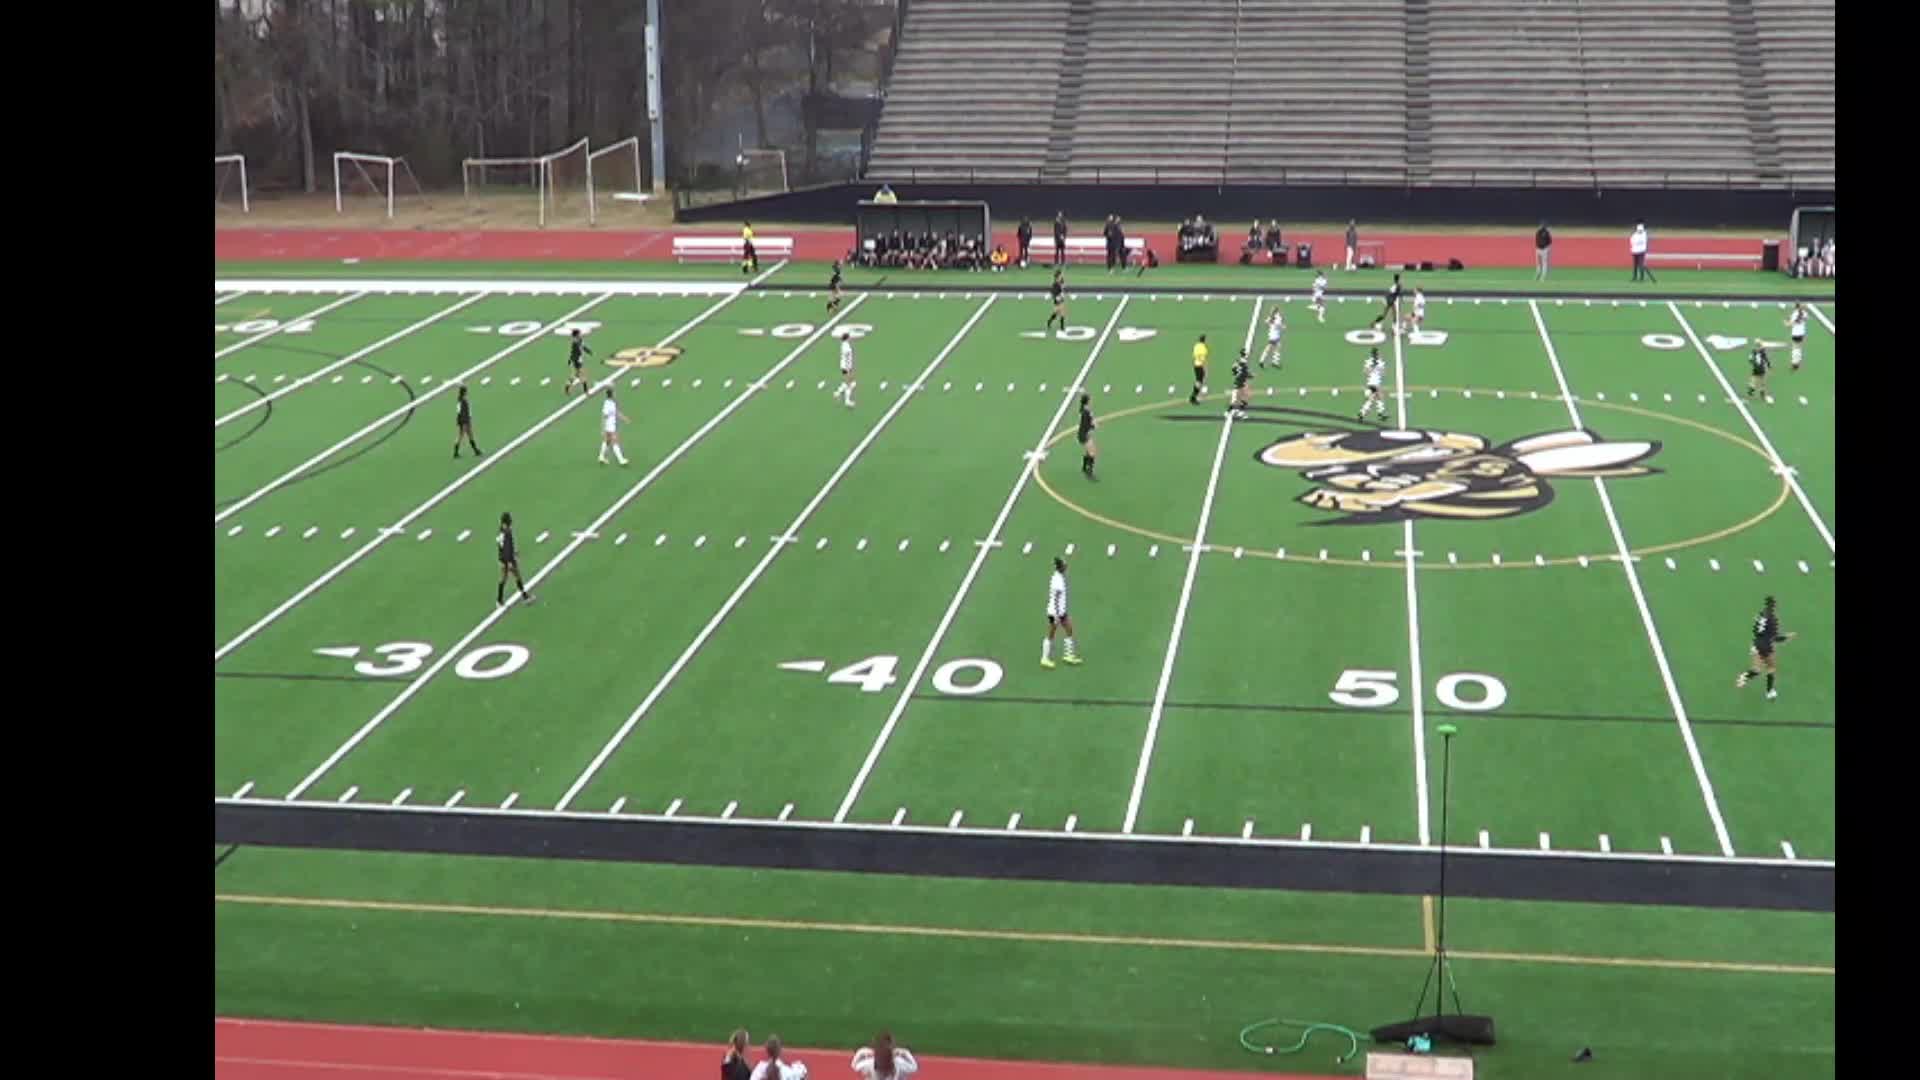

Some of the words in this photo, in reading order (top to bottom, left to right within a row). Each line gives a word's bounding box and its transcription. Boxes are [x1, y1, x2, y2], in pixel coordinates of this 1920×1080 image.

[354, 642, 530, 679] 30
[827, 655, 1004, 695] 40
[1328, 669, 1507, 711] 50
